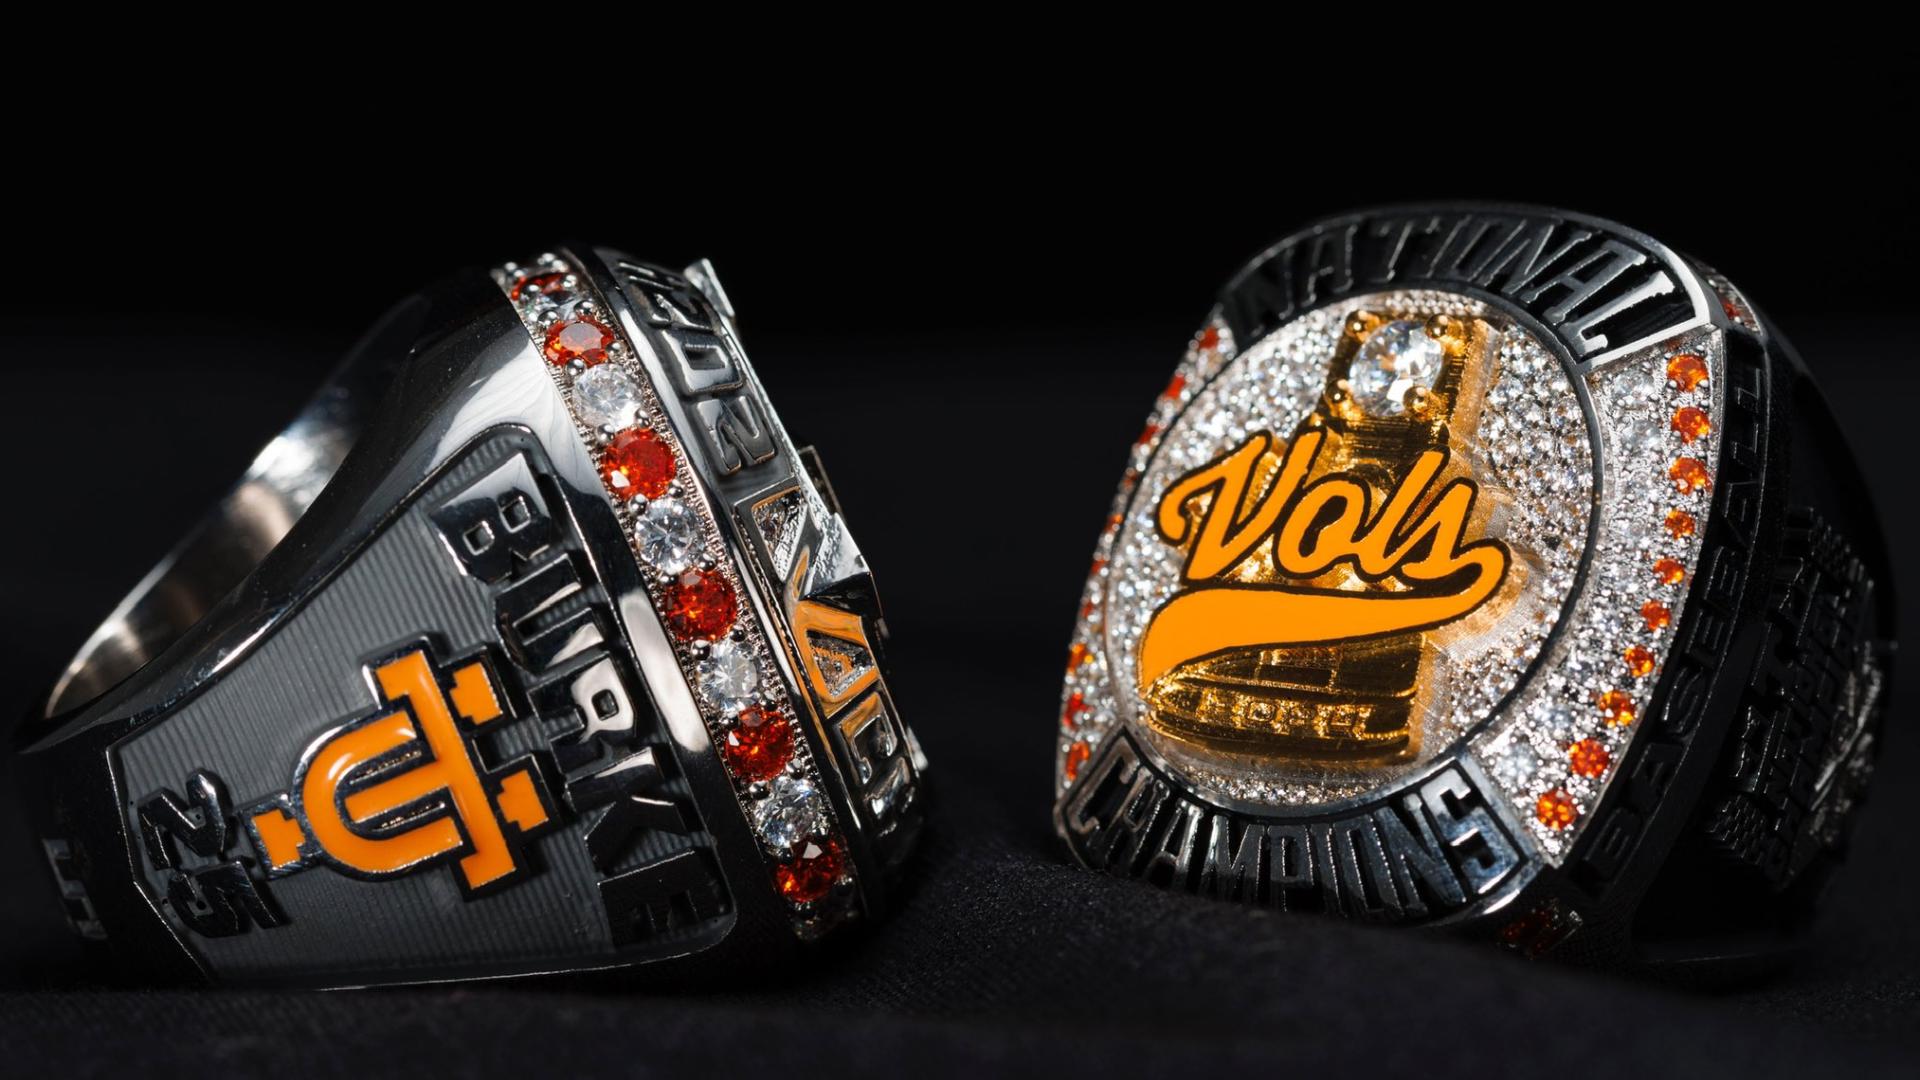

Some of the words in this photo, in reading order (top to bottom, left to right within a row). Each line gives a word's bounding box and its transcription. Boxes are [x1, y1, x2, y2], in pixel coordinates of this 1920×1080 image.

[1228, 214, 1676, 358] NATIONAL
[1152, 424, 1510, 596] Vols
[428, 452, 734, 952] BURKE
[1582, 366, 1764, 896] BASEBALL
[138, 768, 290, 940] 25
[1064, 742, 1522, 924] CHAMPIONS
